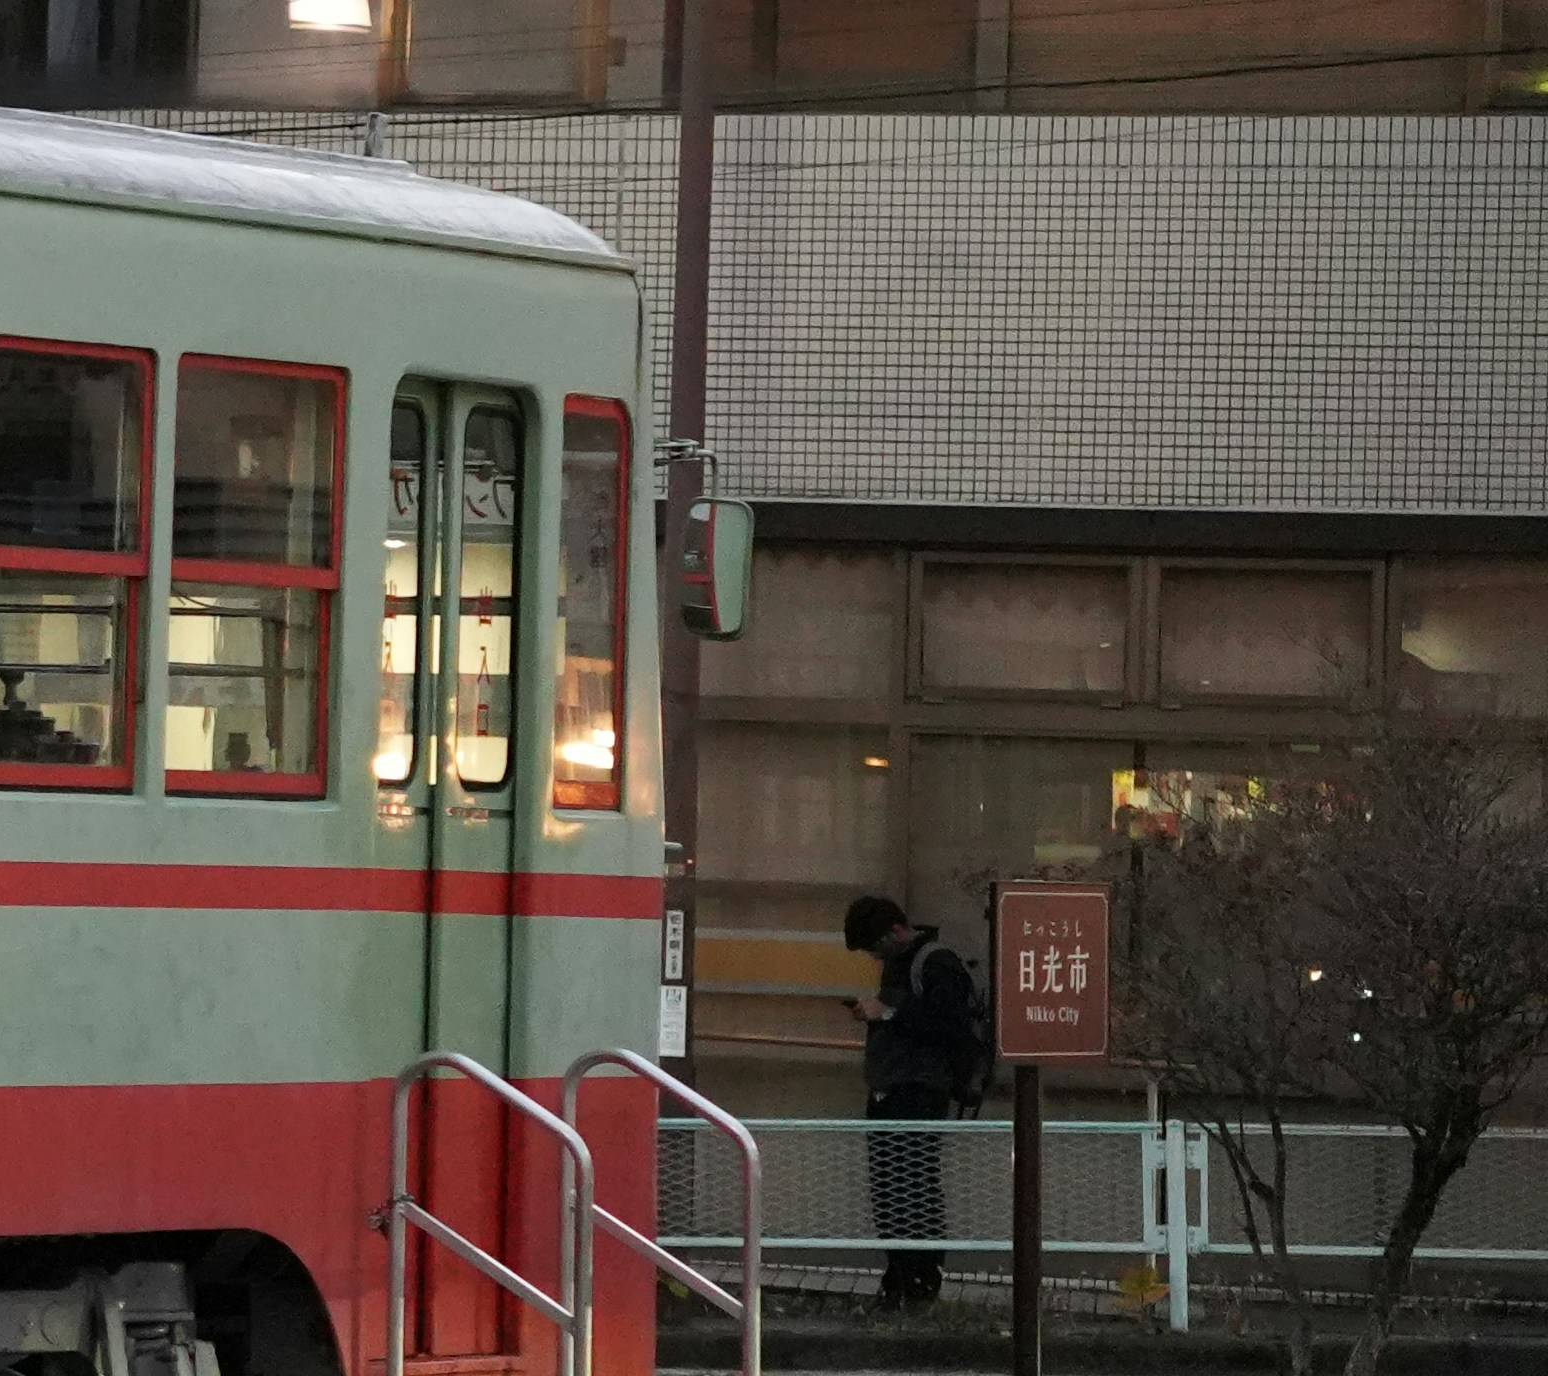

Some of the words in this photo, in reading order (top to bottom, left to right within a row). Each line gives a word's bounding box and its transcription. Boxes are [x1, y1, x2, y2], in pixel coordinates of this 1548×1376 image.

[1023, 919, 1082, 938] にっこうし
[1019, 944, 1090, 995] 日光市
[1026, 1005, 1055, 1023] Nikko
[1058, 1005, 1080, 1026] City
